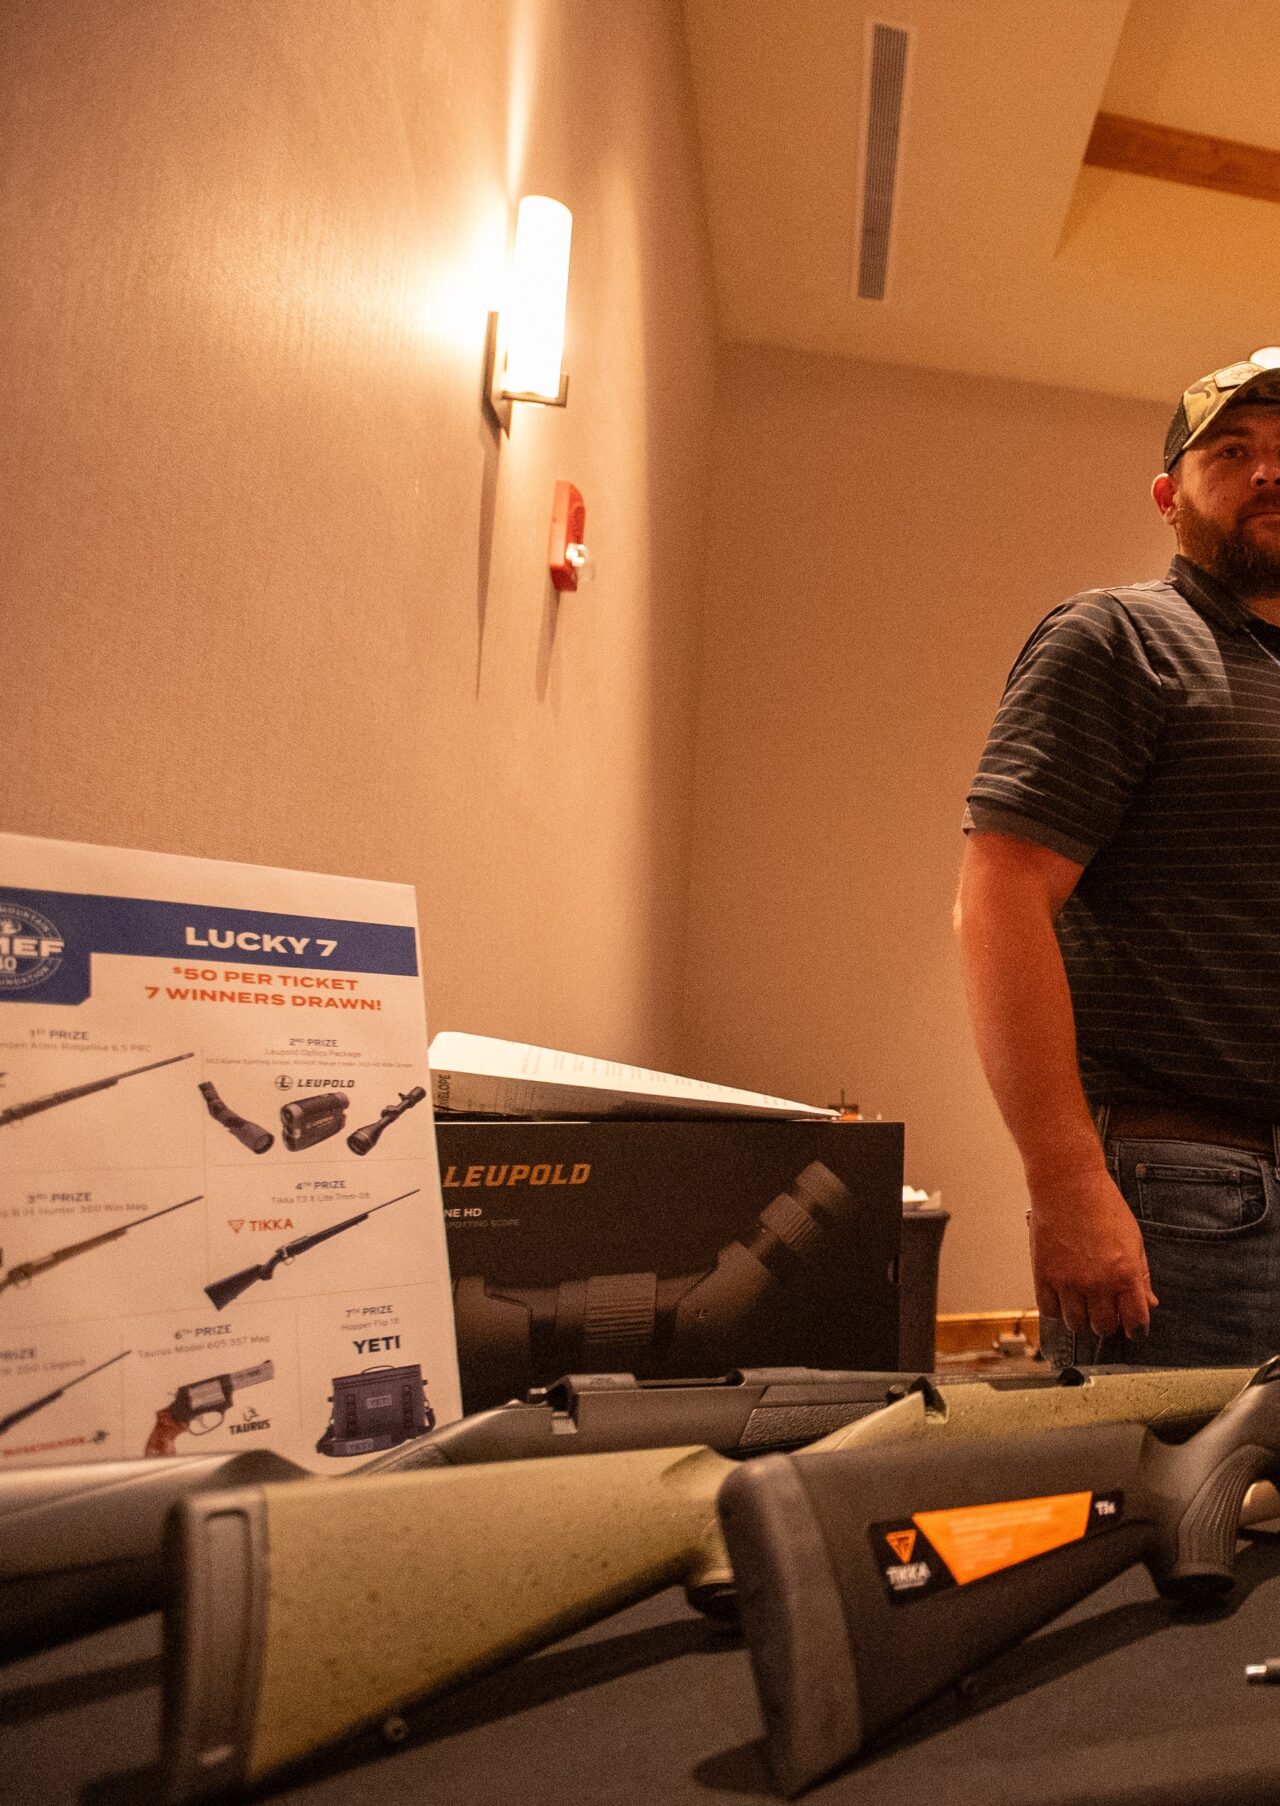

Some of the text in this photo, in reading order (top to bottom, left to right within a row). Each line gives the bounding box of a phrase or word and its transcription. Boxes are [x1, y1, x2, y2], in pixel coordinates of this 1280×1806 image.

[185, 926, 338, 957] LUCKY 7
[173, 966, 359, 991] $50 PER TICKET
[145, 986, 382, 1011] 7 WINNERS DRAWN!
[48, 1030, 89, 1040] PRIZE
[308, 1039, 338, 1048] PRIZE
[297, 1078, 355, 1089] LEUPOLD
[443, 1163, 592, 1188] LEUPOLD
[314, 1180, 346, 1189] PRIZE
[50, 1192, 92, 1202] PRIZE
[464, 1208, 482, 1217] HD
[249, 1218, 294, 1232] TIKKA
[362, 1305, 394, 1316] PRIZE
[195, 1324, 232, 1337] PRIZE
[353, 1335, 401, 1355] YETI
[229, 1420, 271, 1435] TAURUS
